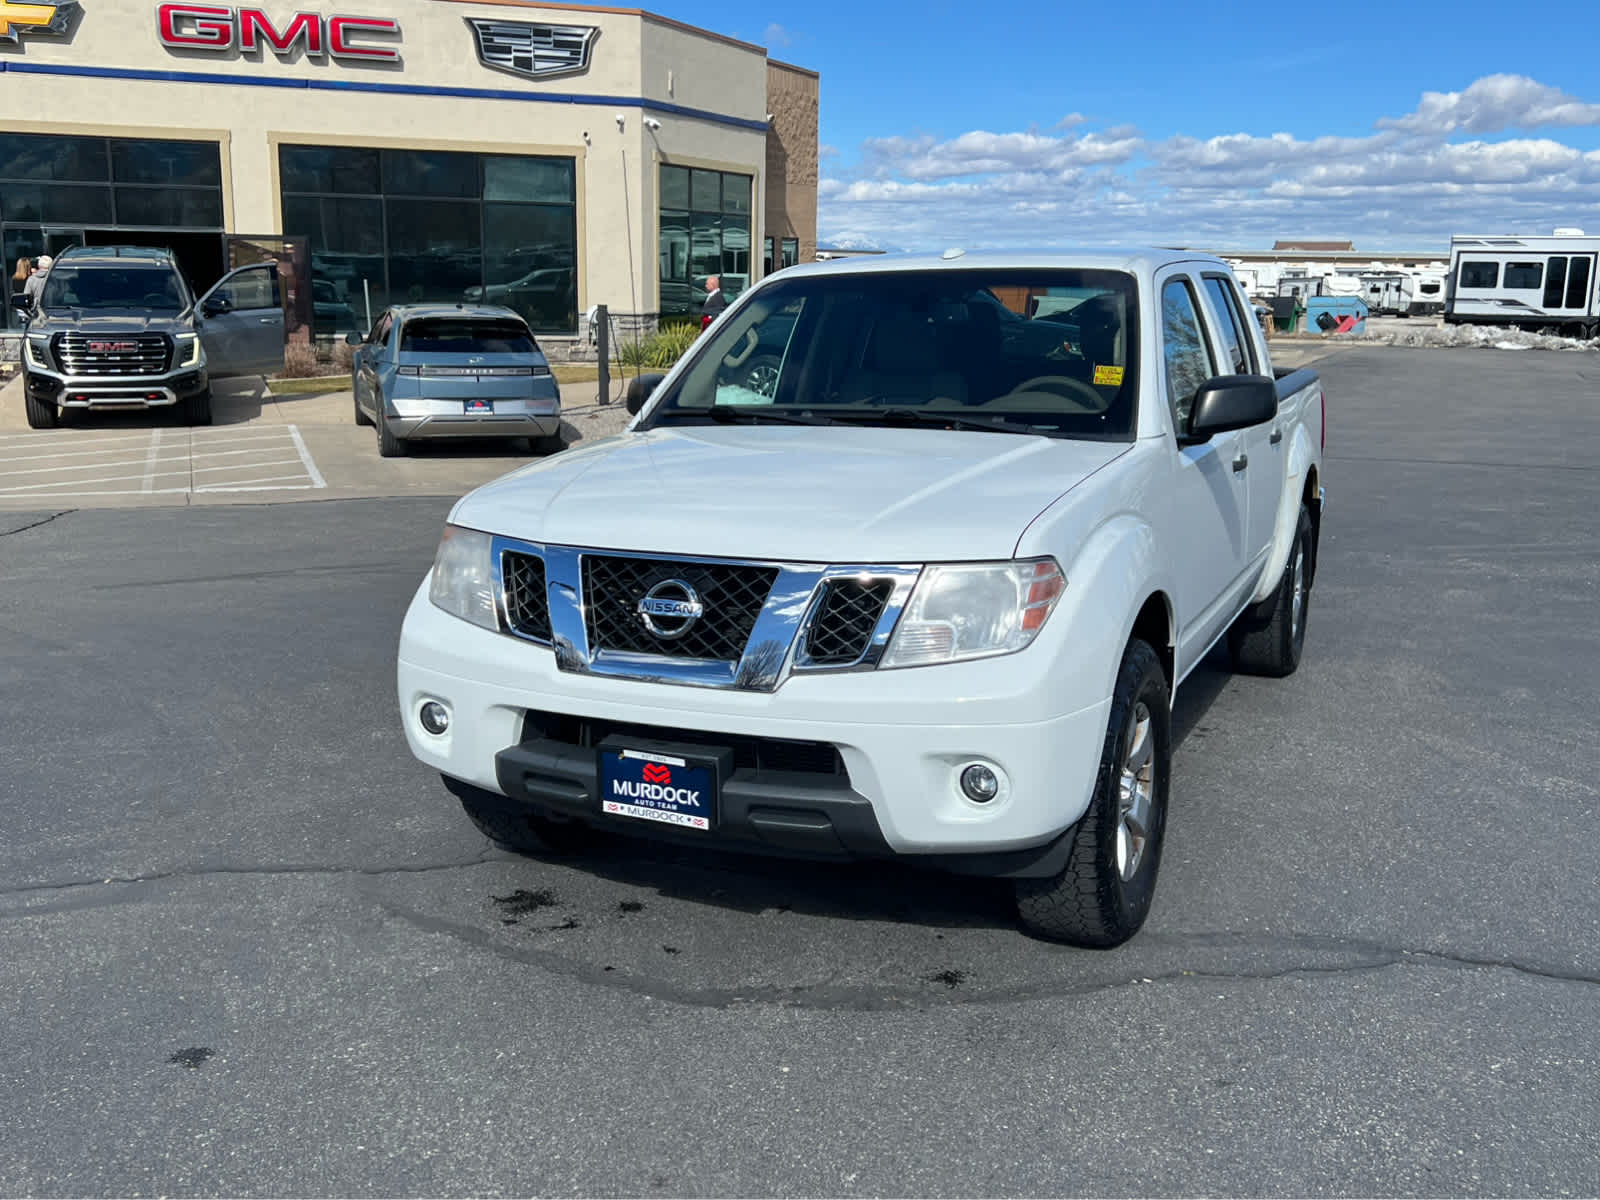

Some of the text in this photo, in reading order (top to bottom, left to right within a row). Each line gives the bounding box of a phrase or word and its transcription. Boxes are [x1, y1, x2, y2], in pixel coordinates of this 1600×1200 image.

[155, 1, 401, 61] GMC
[89, 342, 136, 351] GMC
[642, 601, 694, 614] NISSAN
[613, 779, 700, 807] MURDOCK
[634, 799, 678, 810] AUTO TEAM
[627, 806, 684, 824] MURDOCK
